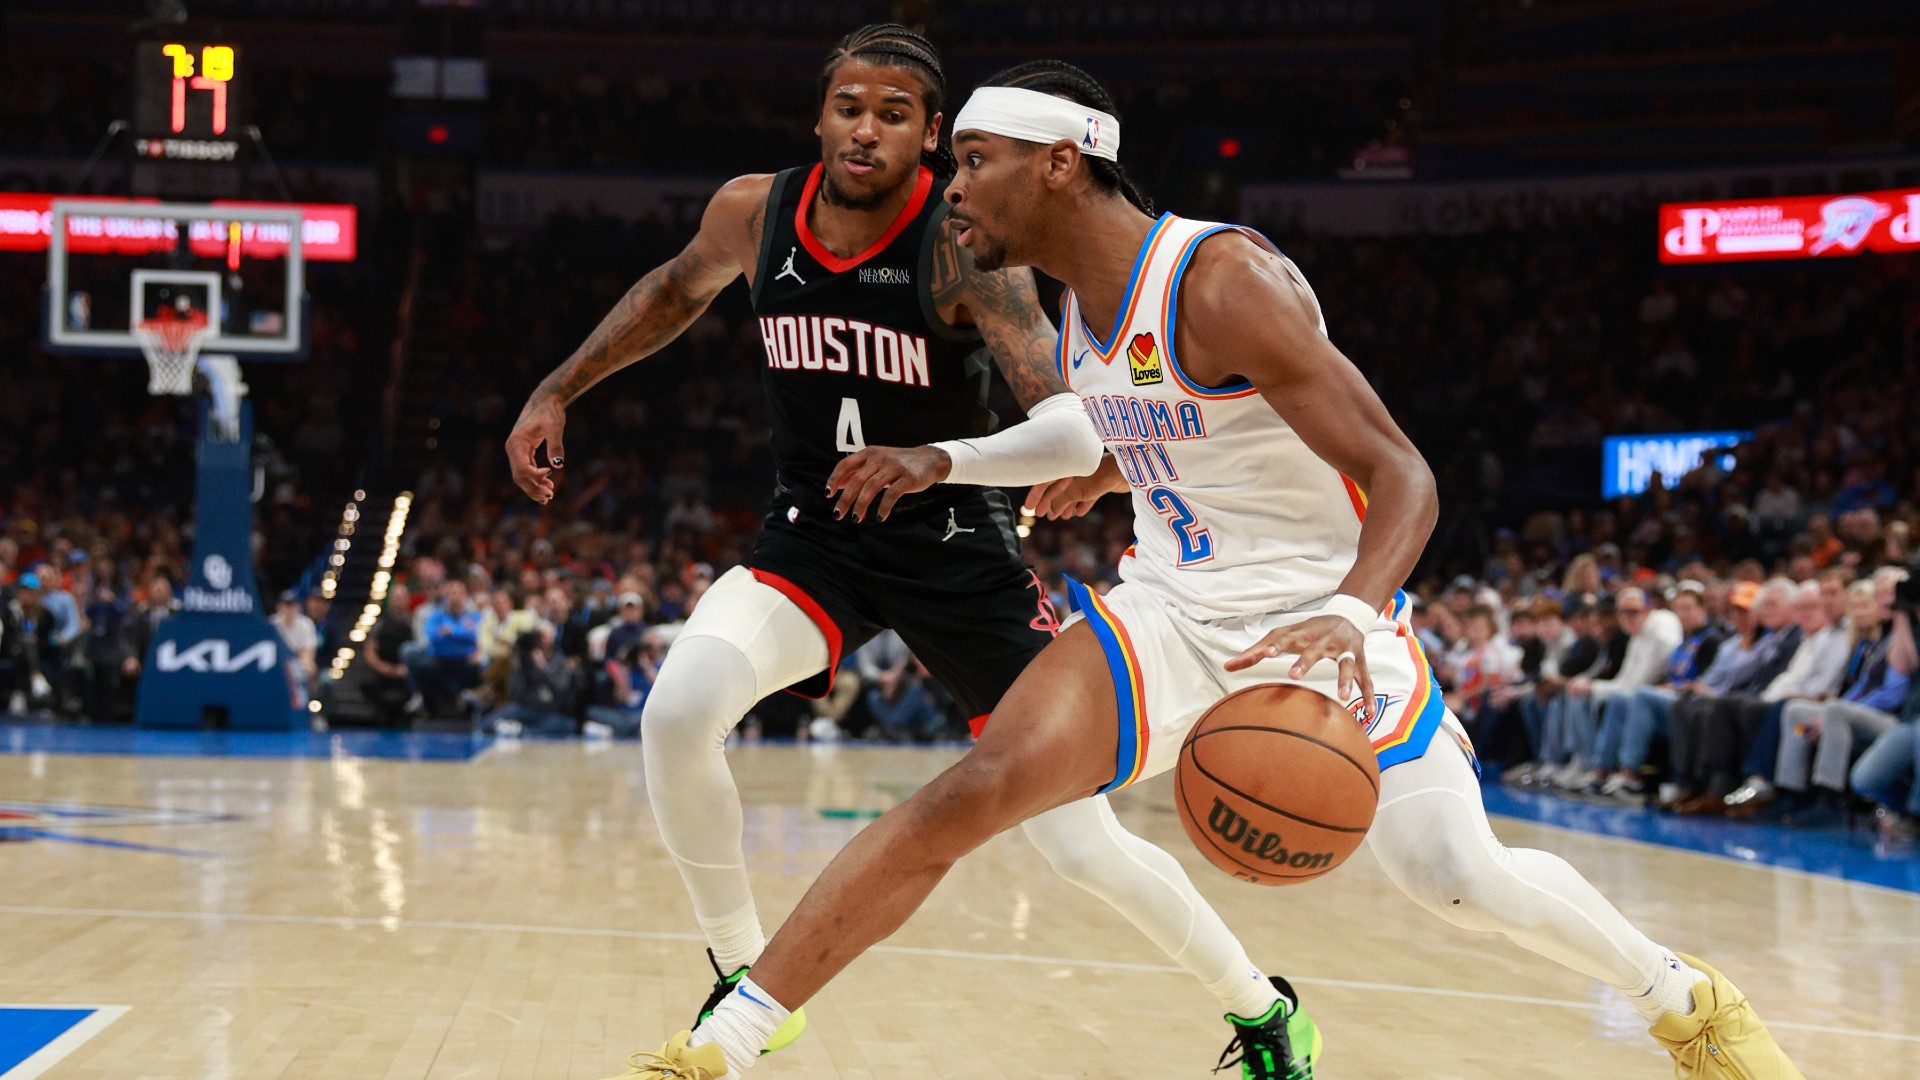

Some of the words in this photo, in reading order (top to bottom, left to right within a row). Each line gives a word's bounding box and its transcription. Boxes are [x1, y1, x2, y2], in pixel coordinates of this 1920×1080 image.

[859, 267, 910, 278] MEMORIAL
[859, 275, 910, 284] HERMANN
[759, 316, 931, 388] HOUSTON
[836, 397, 867, 453] 4
[1115, 442, 1179, 488] CITY
[1147, 485, 1215, 567] 2
[1207, 796, 1334, 869] Wilson
